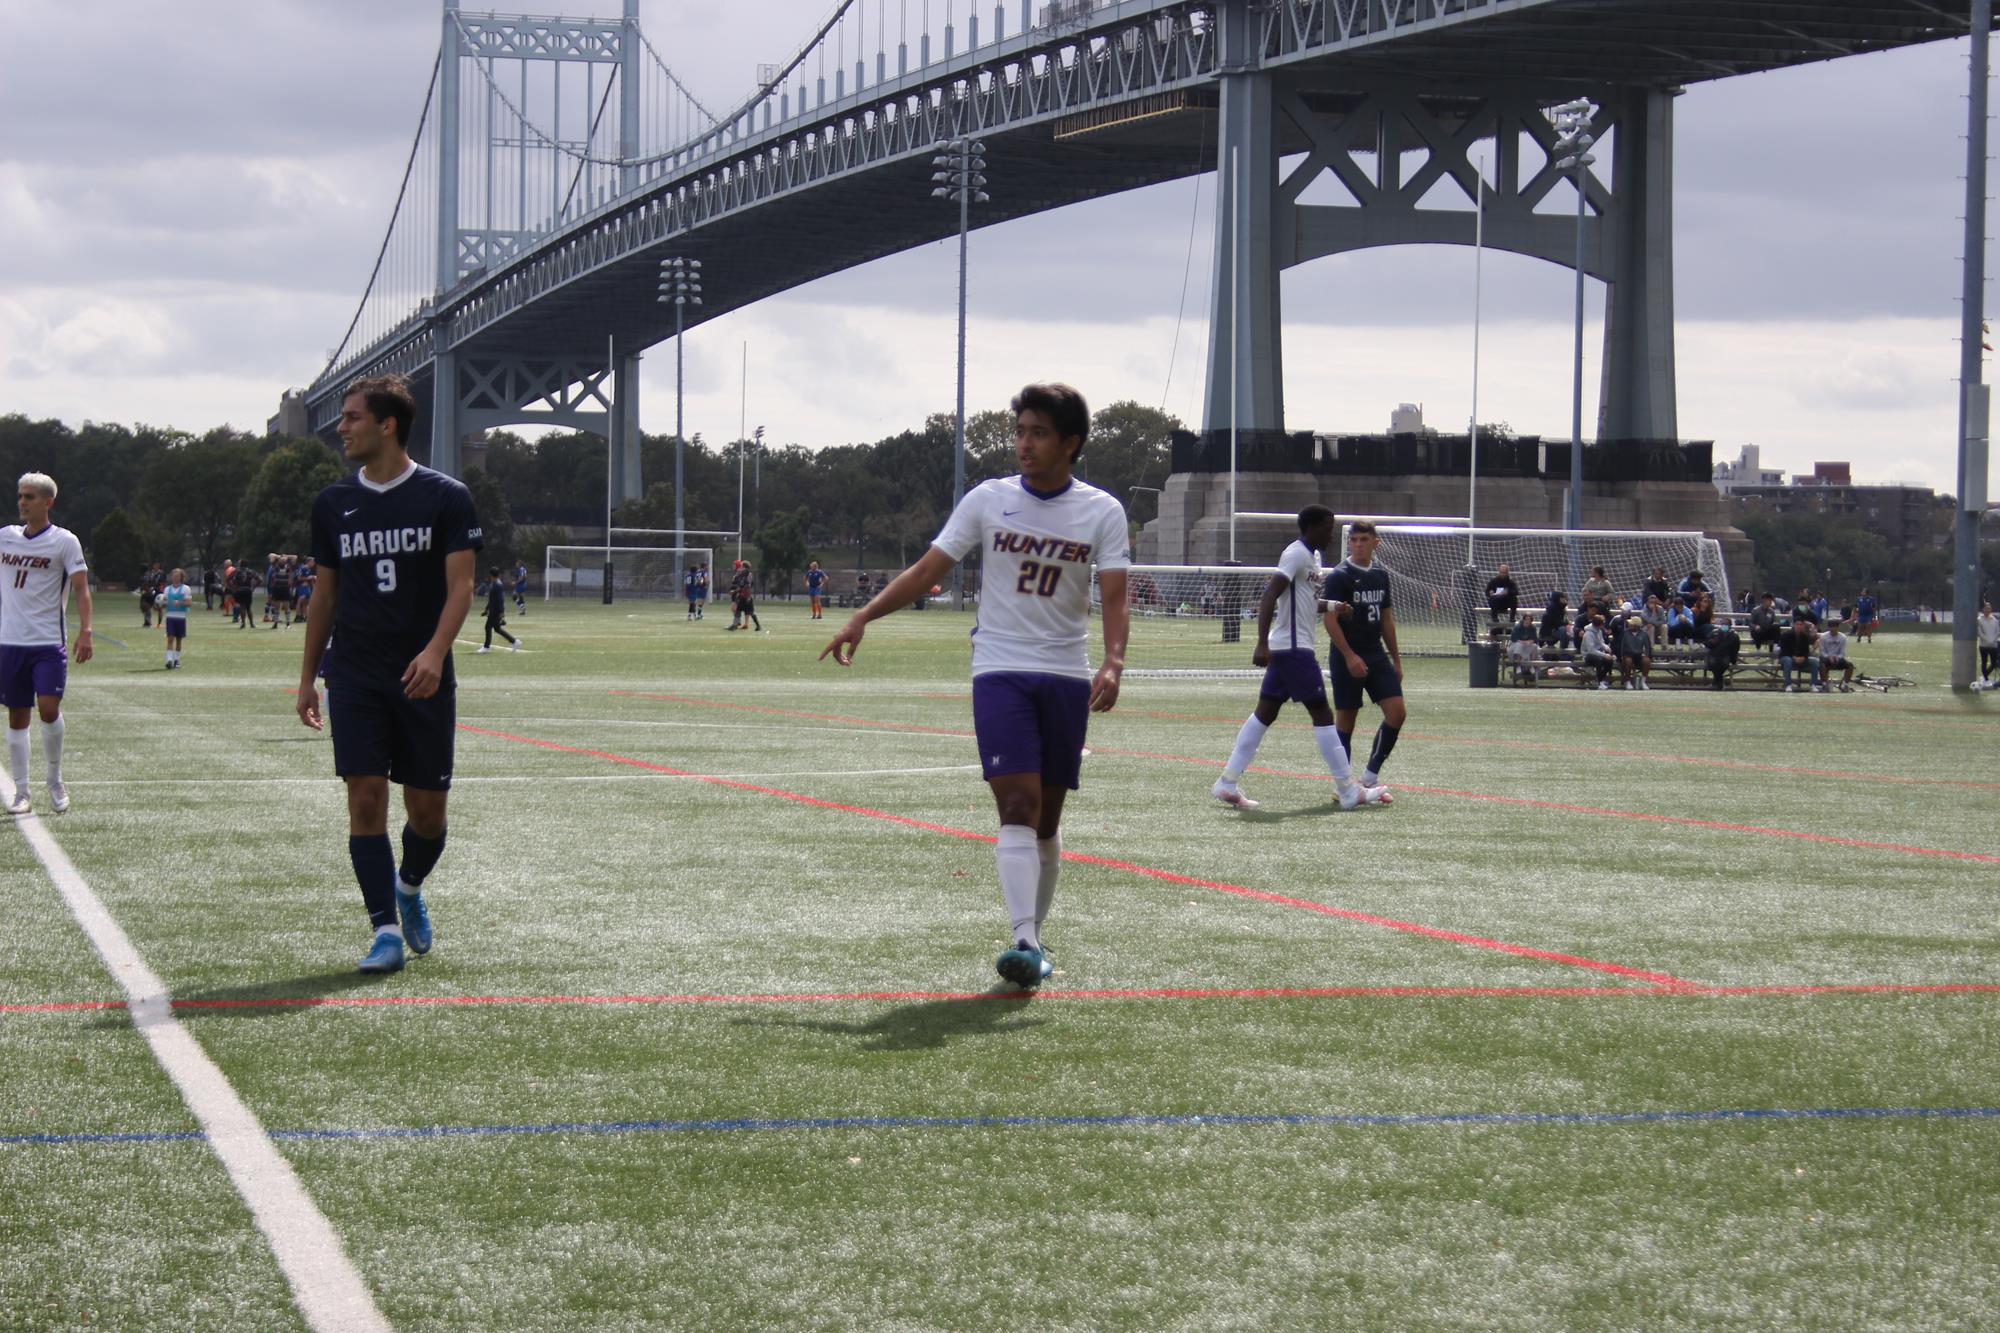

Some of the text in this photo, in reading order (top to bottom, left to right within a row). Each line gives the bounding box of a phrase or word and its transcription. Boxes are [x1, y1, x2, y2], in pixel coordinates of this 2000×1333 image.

[340, 527, 432, 558] BARUCH
[993, 531, 1092, 563] HUNTER
[1, 552, 51, 569] HUNTER
[376, 558, 397, 592] 9
[14, 570, 28, 589] 11
[1017, 560, 1062, 597] 20
[1367, 604, 1380, 621] 21
